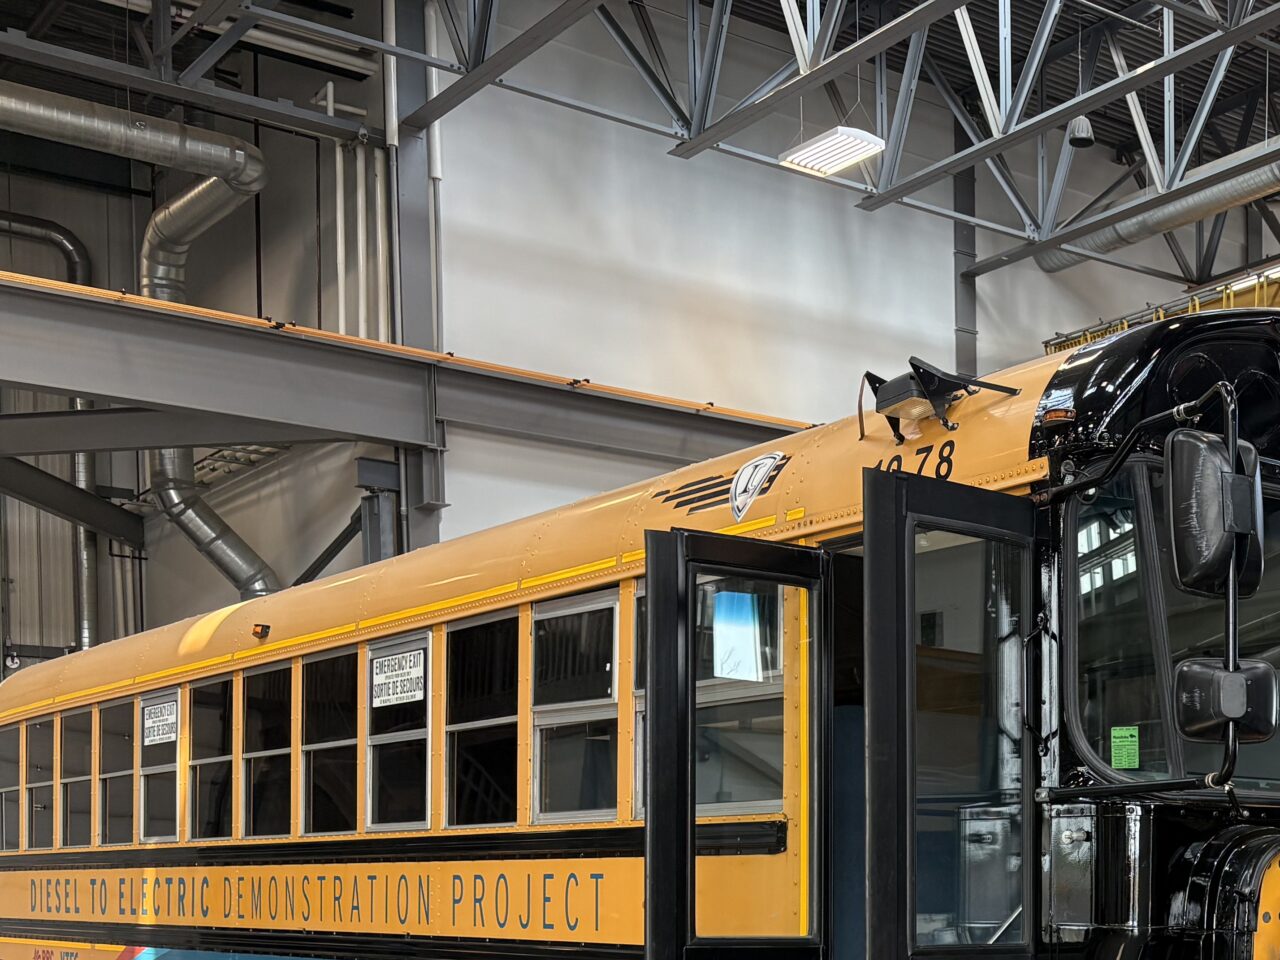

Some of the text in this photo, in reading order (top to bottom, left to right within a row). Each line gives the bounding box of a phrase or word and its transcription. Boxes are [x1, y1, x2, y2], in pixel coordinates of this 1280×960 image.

[375, 652, 422, 675] EMERGENCY EXIT
[374, 676, 423, 698] SORTIE DE SECOURS
[30, 872, 604, 931] DIESEL TO ELECTRIC DEMONSTRATION PROJECT
